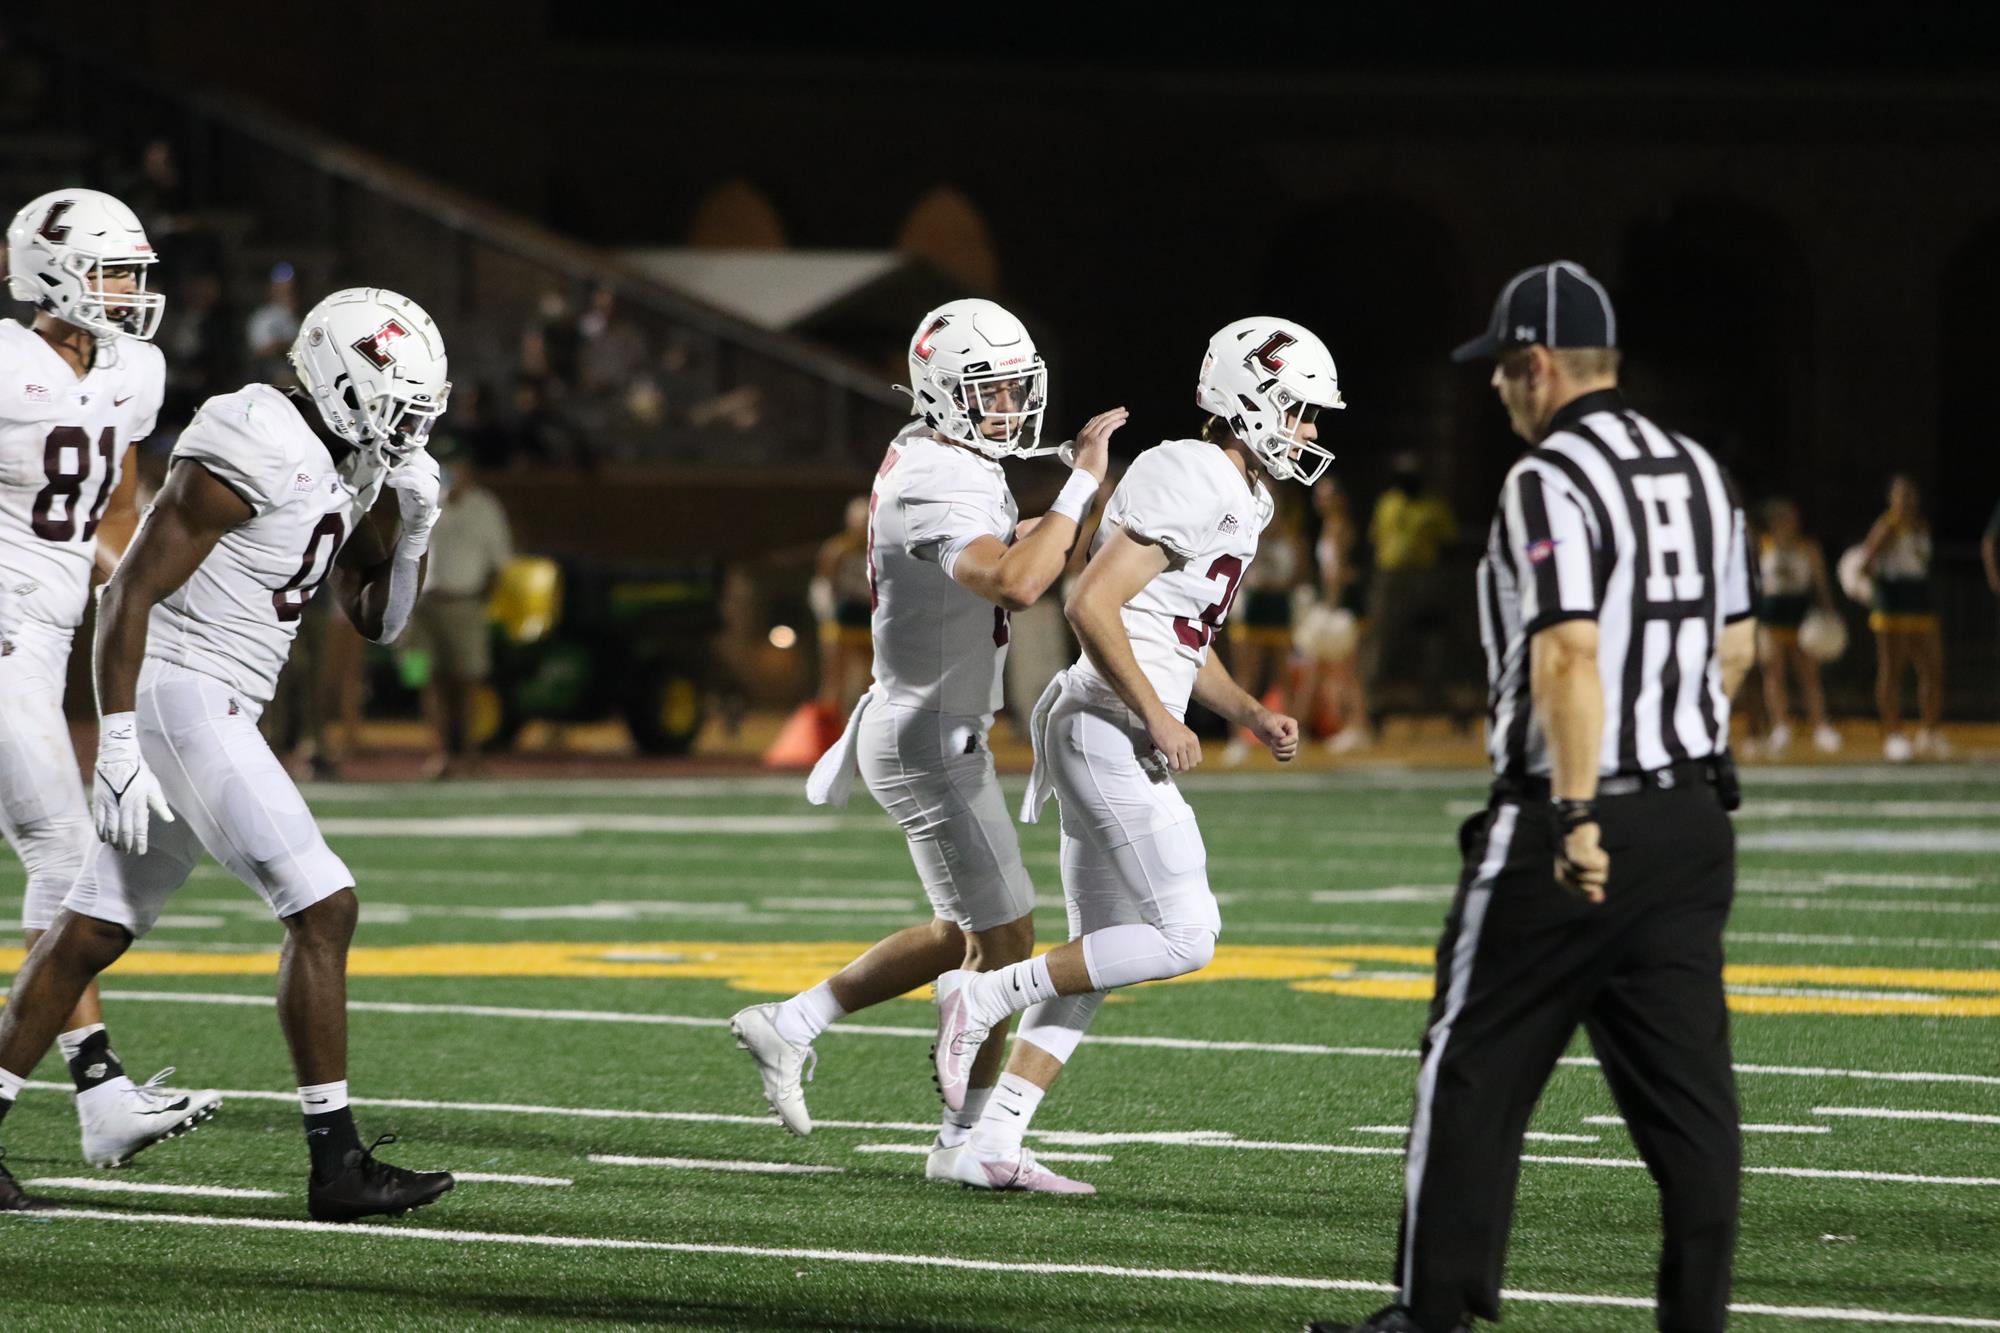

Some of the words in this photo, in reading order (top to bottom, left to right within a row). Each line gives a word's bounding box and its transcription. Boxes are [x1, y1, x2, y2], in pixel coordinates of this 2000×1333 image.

[36, 202, 77, 246] L
[912, 316, 950, 366] L
[1244, 331, 1298, 376] L
[31, 425, 116, 542] 81
[271, 511, 345, 622] 0
